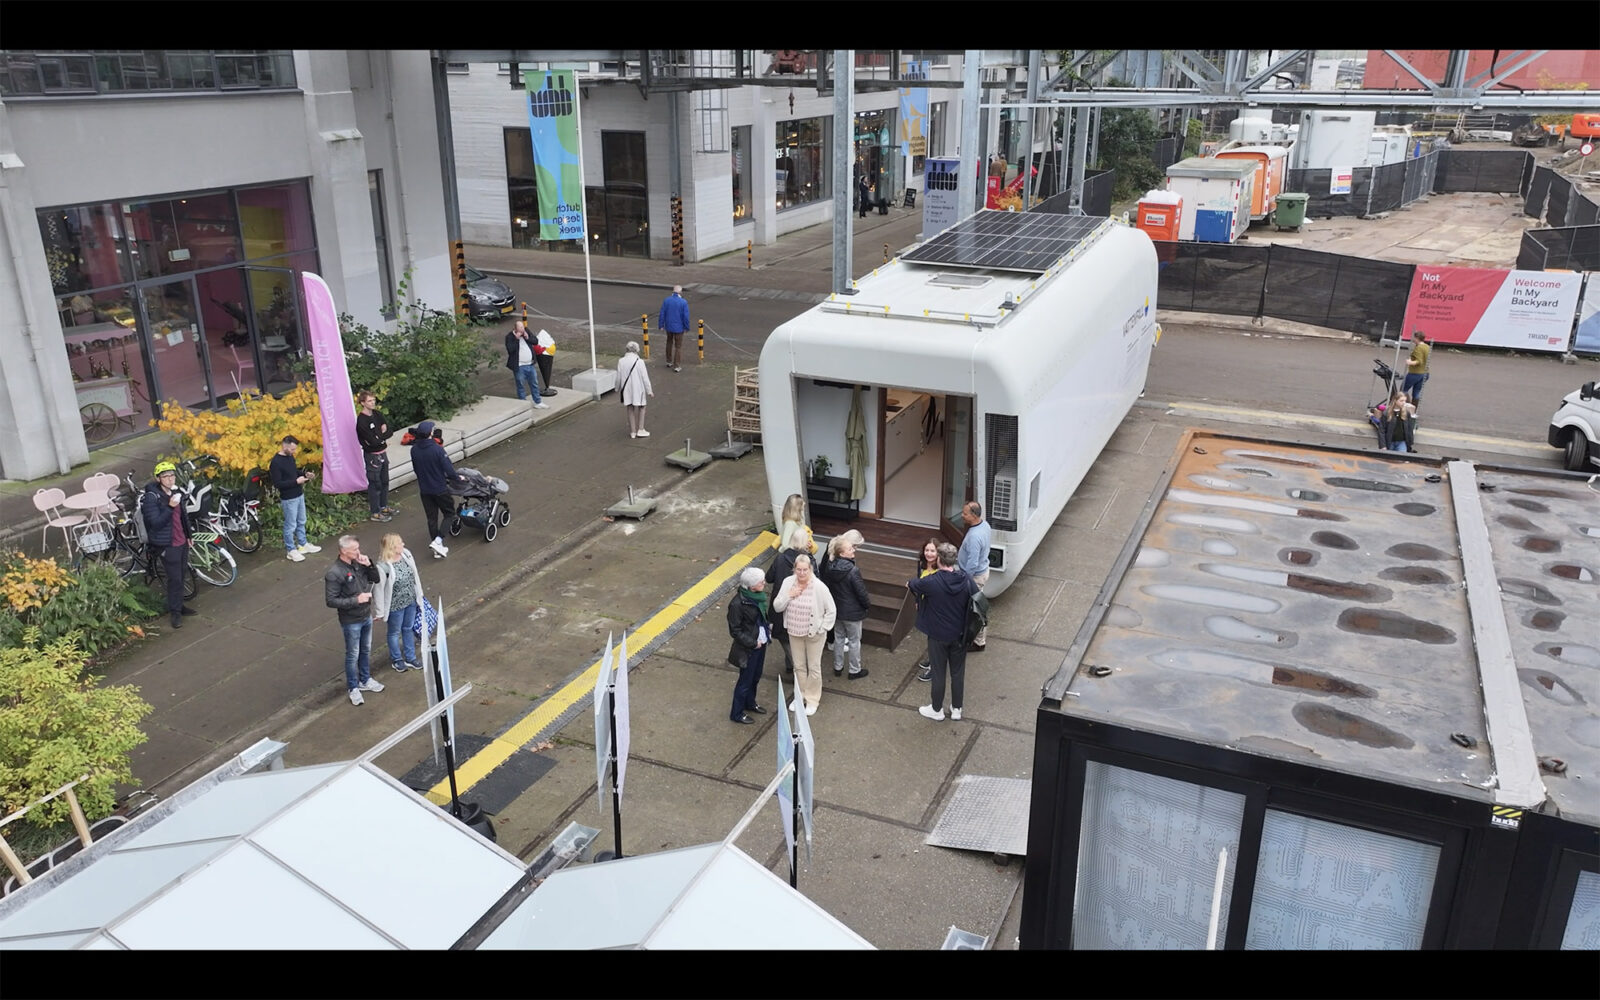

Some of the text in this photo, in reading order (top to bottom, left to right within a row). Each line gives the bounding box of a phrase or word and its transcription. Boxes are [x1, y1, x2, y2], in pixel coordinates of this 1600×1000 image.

[1422, 273, 1440, 282] Not
[1432, 283, 1447, 293] My
[1514, 278, 1562, 289] Welcome
[1419, 292, 1465, 302] Backyard
[1512, 288, 1541, 299] In My
[1511, 297, 1559, 308] Backyard
